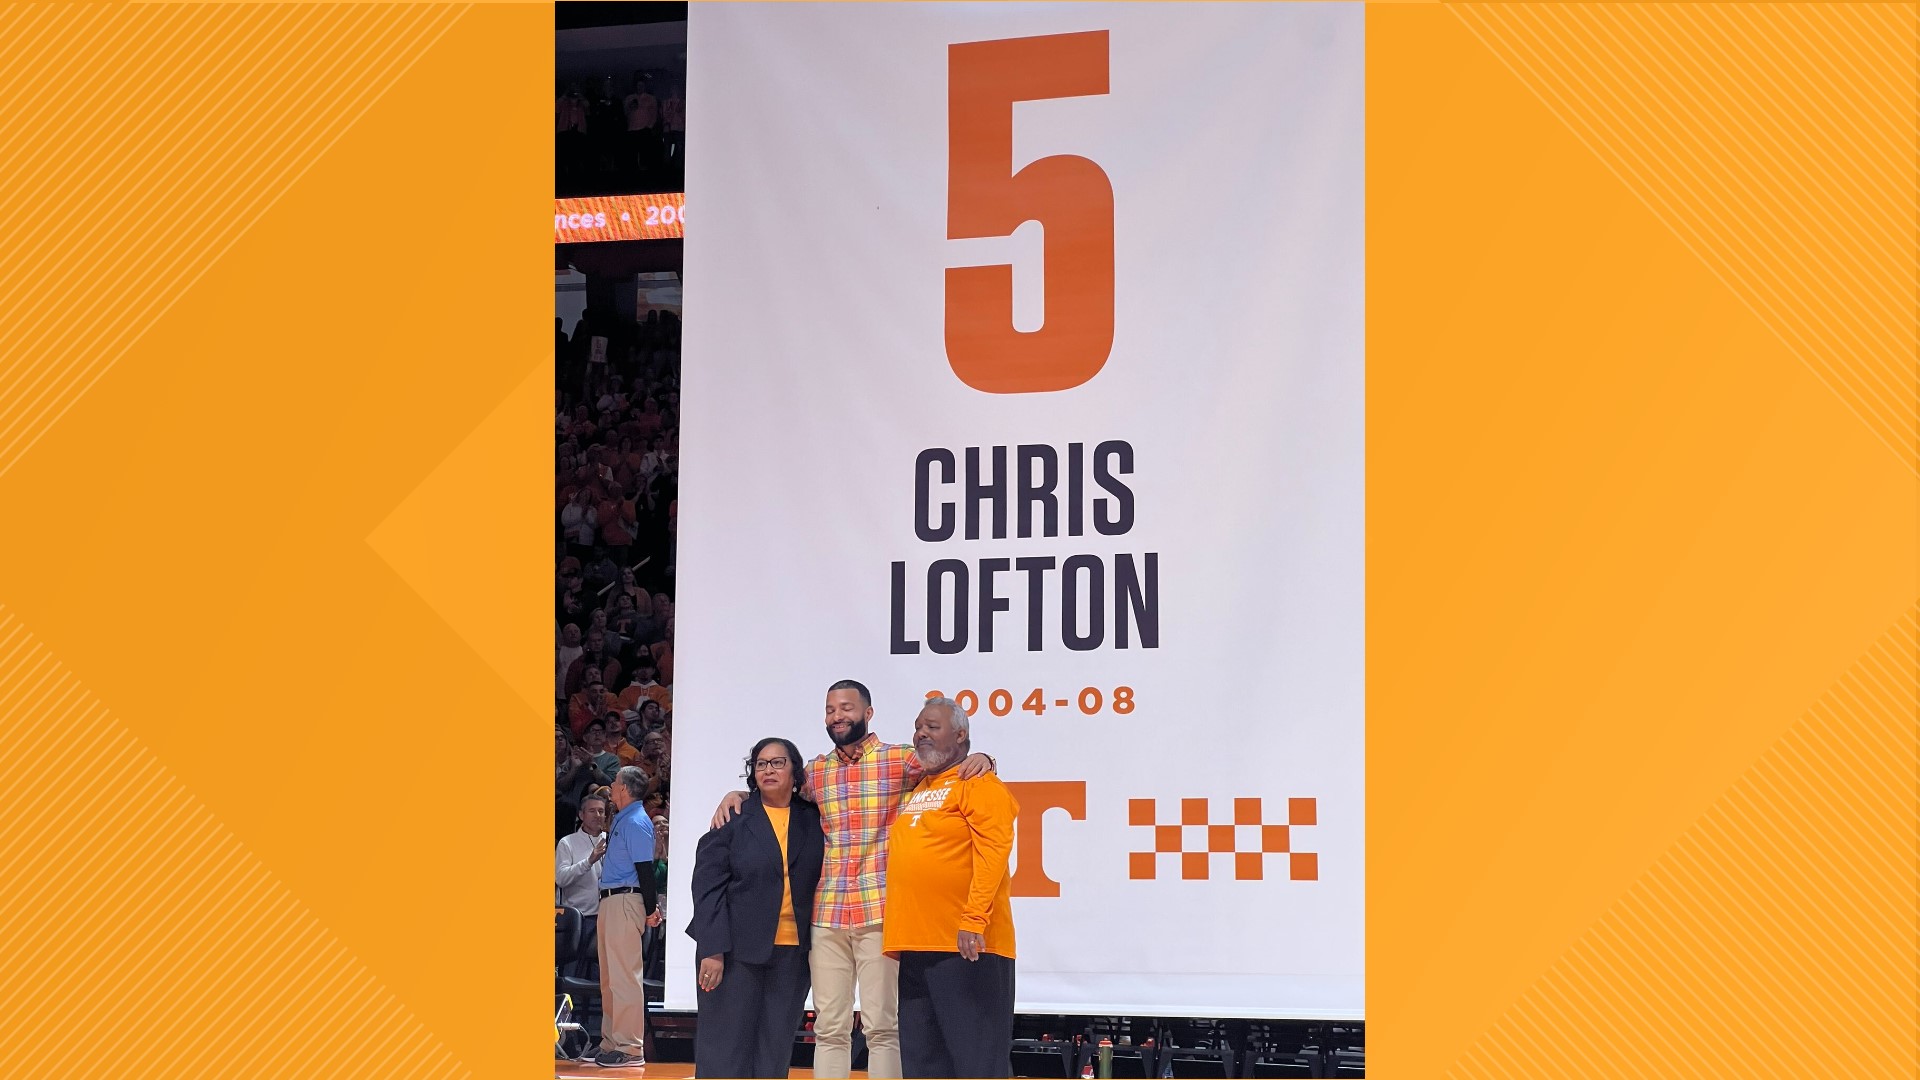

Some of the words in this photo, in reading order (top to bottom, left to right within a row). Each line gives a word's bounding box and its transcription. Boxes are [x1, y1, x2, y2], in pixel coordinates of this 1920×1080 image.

[945, 30, 1115, 395] 5
[915, 440, 1135, 542] CHRIS
[890, 553, 1159, 655] LOFTON
[1002, 780, 1087, 898] T
